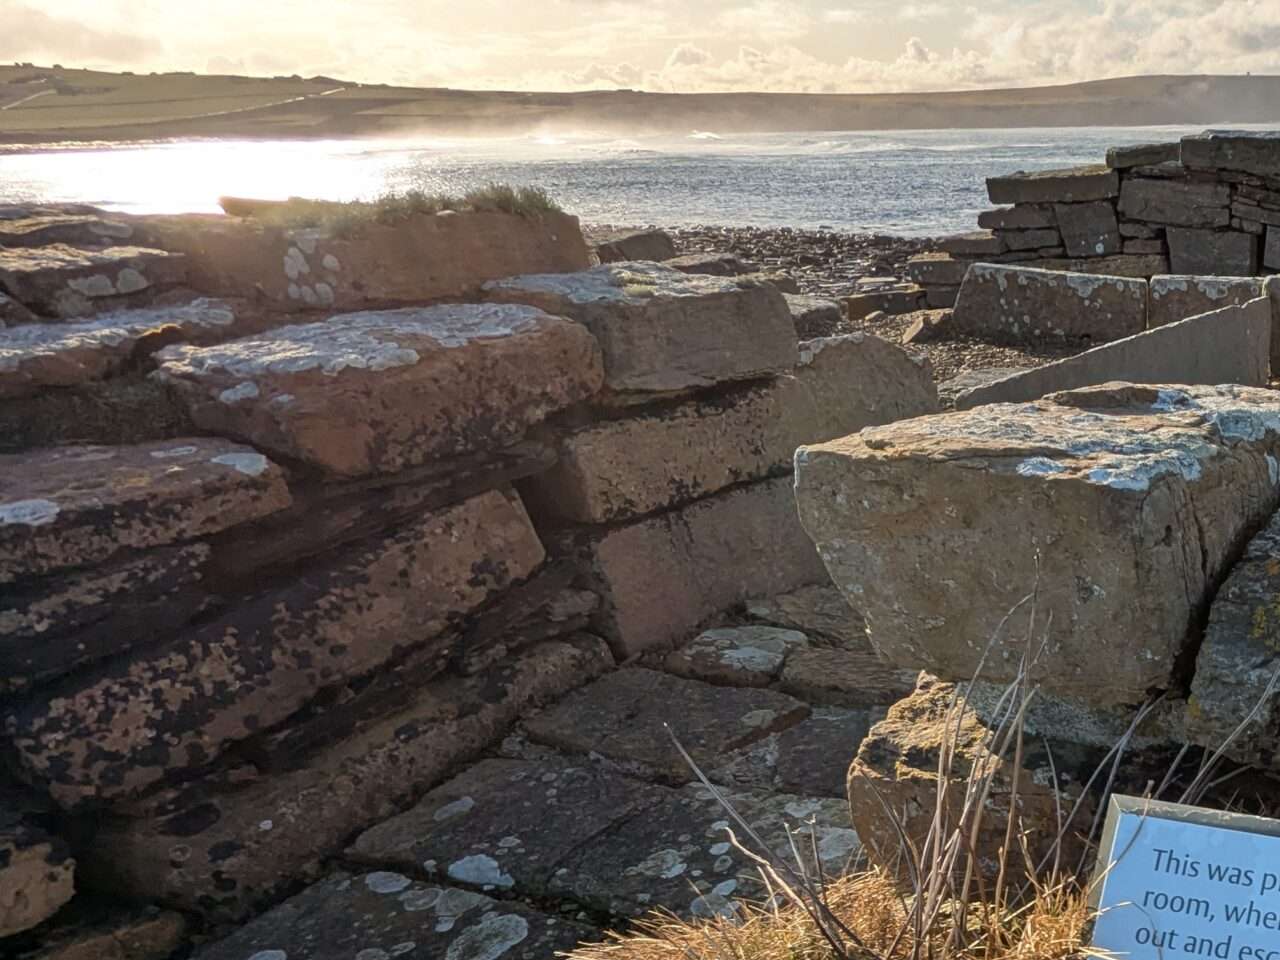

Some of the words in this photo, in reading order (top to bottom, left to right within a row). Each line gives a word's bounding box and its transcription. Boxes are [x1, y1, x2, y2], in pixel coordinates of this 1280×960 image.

[1153, 848, 1201, 878] This
[1208, 863, 1255, 887] was
[1142, 891, 1216, 923] room,
[1135, 925, 1179, 951] out
[1183, 935, 1233, 960] and
